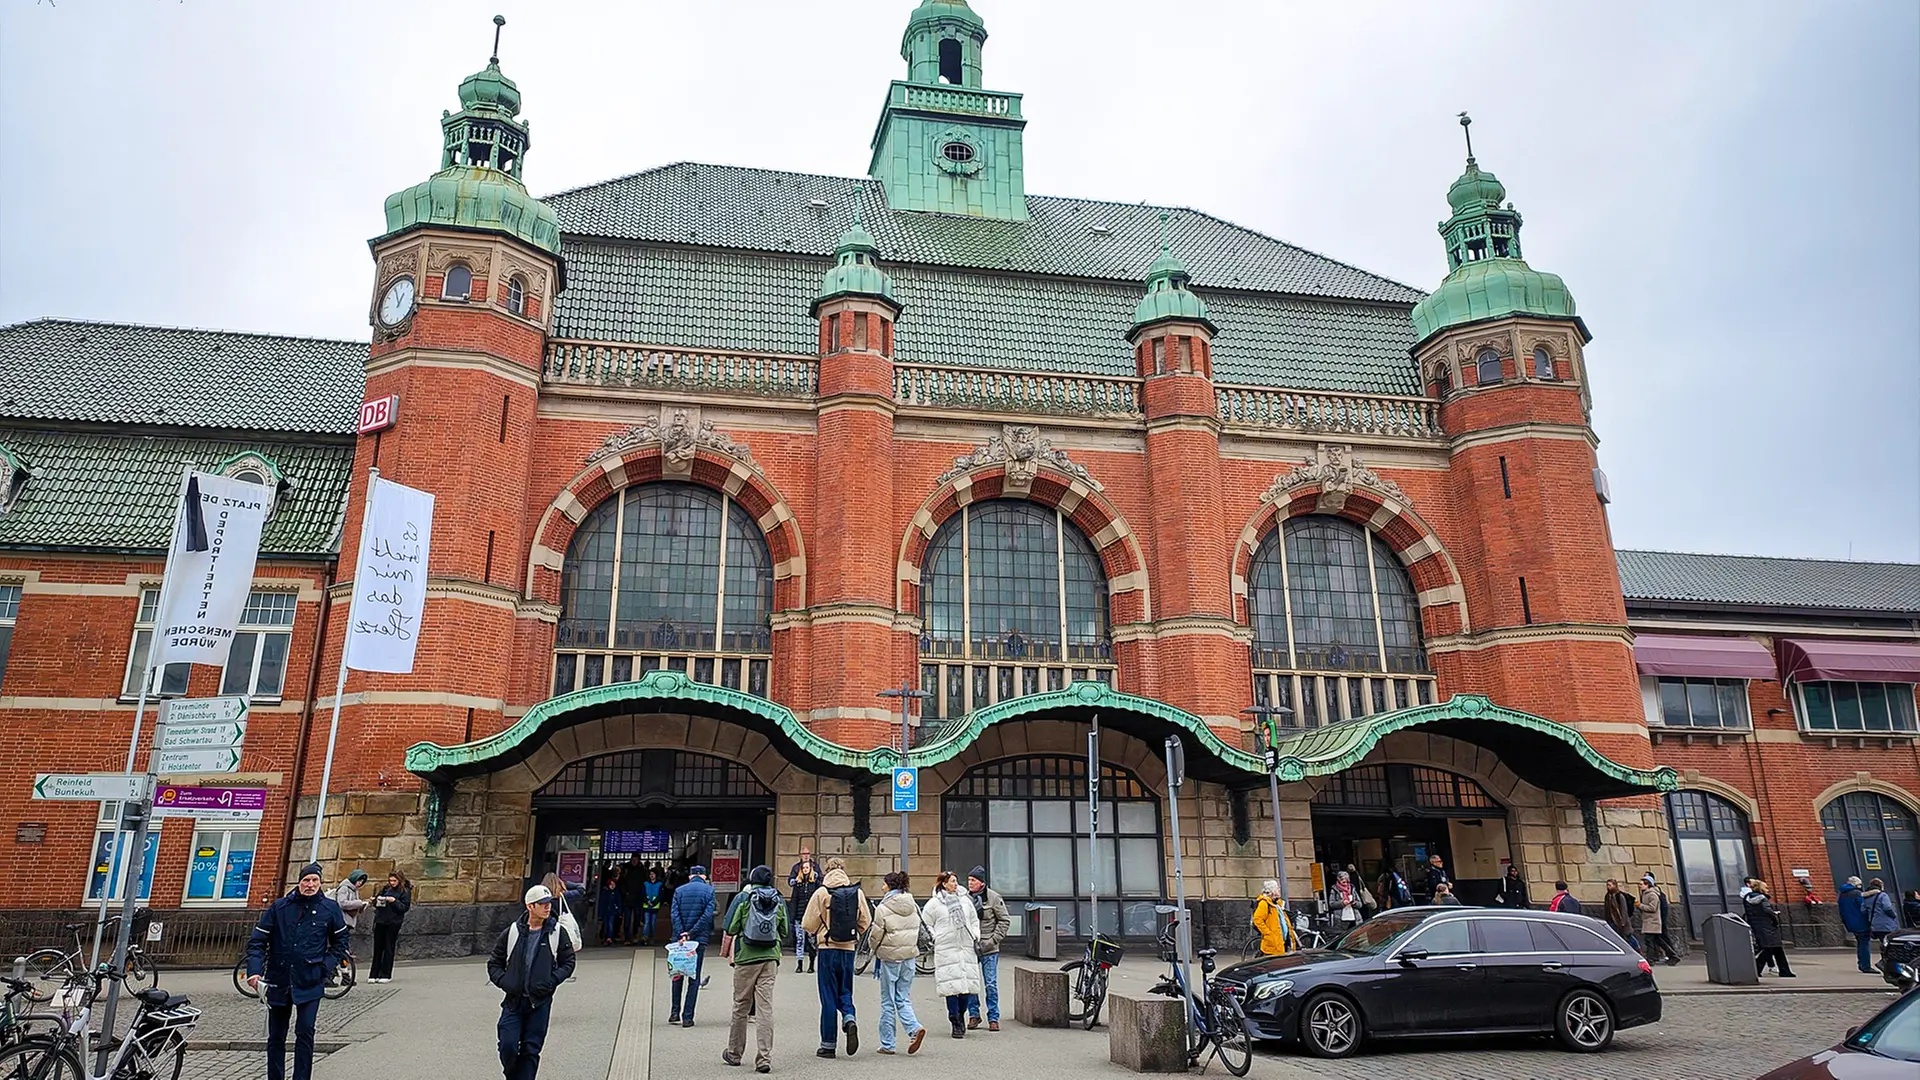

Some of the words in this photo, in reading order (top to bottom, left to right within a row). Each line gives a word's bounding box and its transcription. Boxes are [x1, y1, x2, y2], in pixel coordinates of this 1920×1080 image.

[363, 401, 387, 427] DB
[171, 702, 210, 711] Travemünde
[177, 712, 217, 720] Dänischburg
[166, 727, 200, 736] Timmendorfer
[200, 726, 217, 734] Strand
[164, 738, 176, 746] Bad
[179, 737, 212, 745] Schwartau
[161, 753, 189, 761] Zentrum
[167, 762, 202, 771] Holstentor
[56, 778, 92, 786] Reinfeld
[55, 788, 95, 796] Buntekuh
